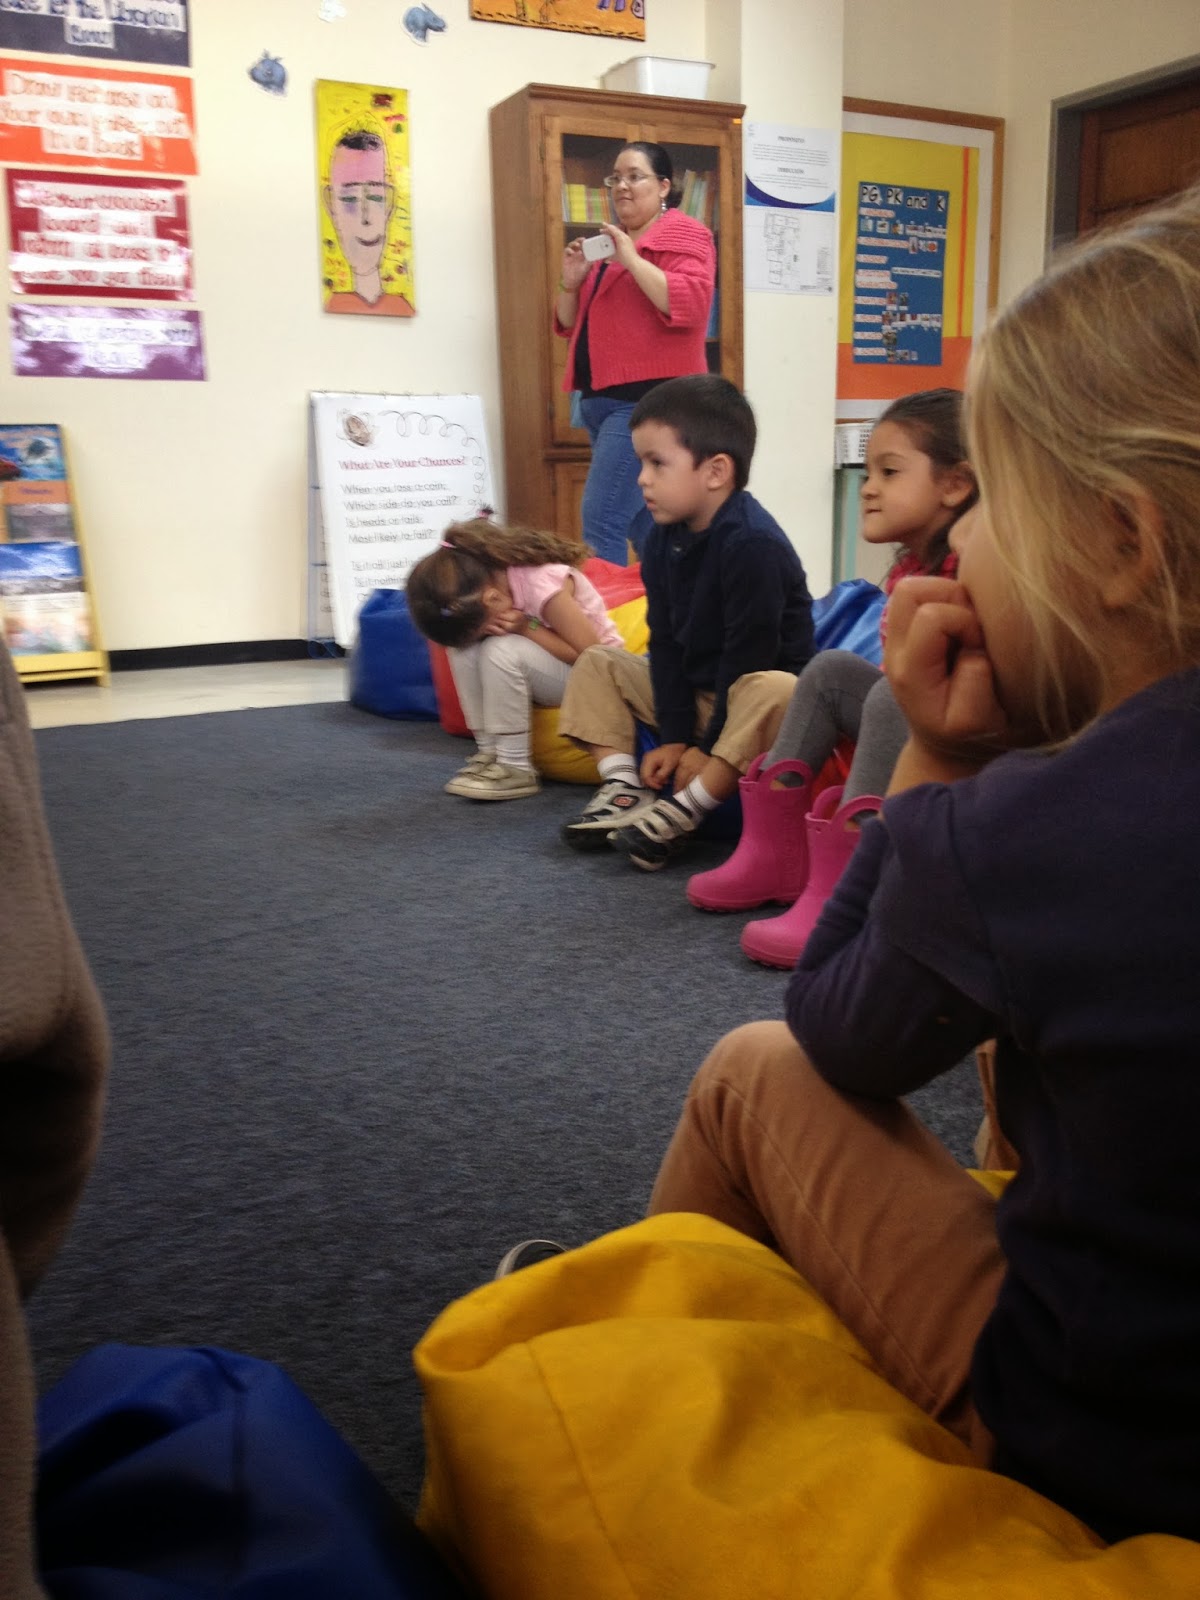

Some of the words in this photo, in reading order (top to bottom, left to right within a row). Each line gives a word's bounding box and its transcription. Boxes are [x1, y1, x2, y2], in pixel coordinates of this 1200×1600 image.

[906, 194, 928, 209] and
[339, 459, 371, 470] What
[373, 459, 390, 469] Are
[393, 458, 417, 468] Your
[341, 484, 371, 494] When
[344, 500, 376, 511] Which
[379, 499, 398, 509] side
[400, 499, 413, 508] do
[417, 499, 433, 509] you
[436, 495, 457, 506] call?
